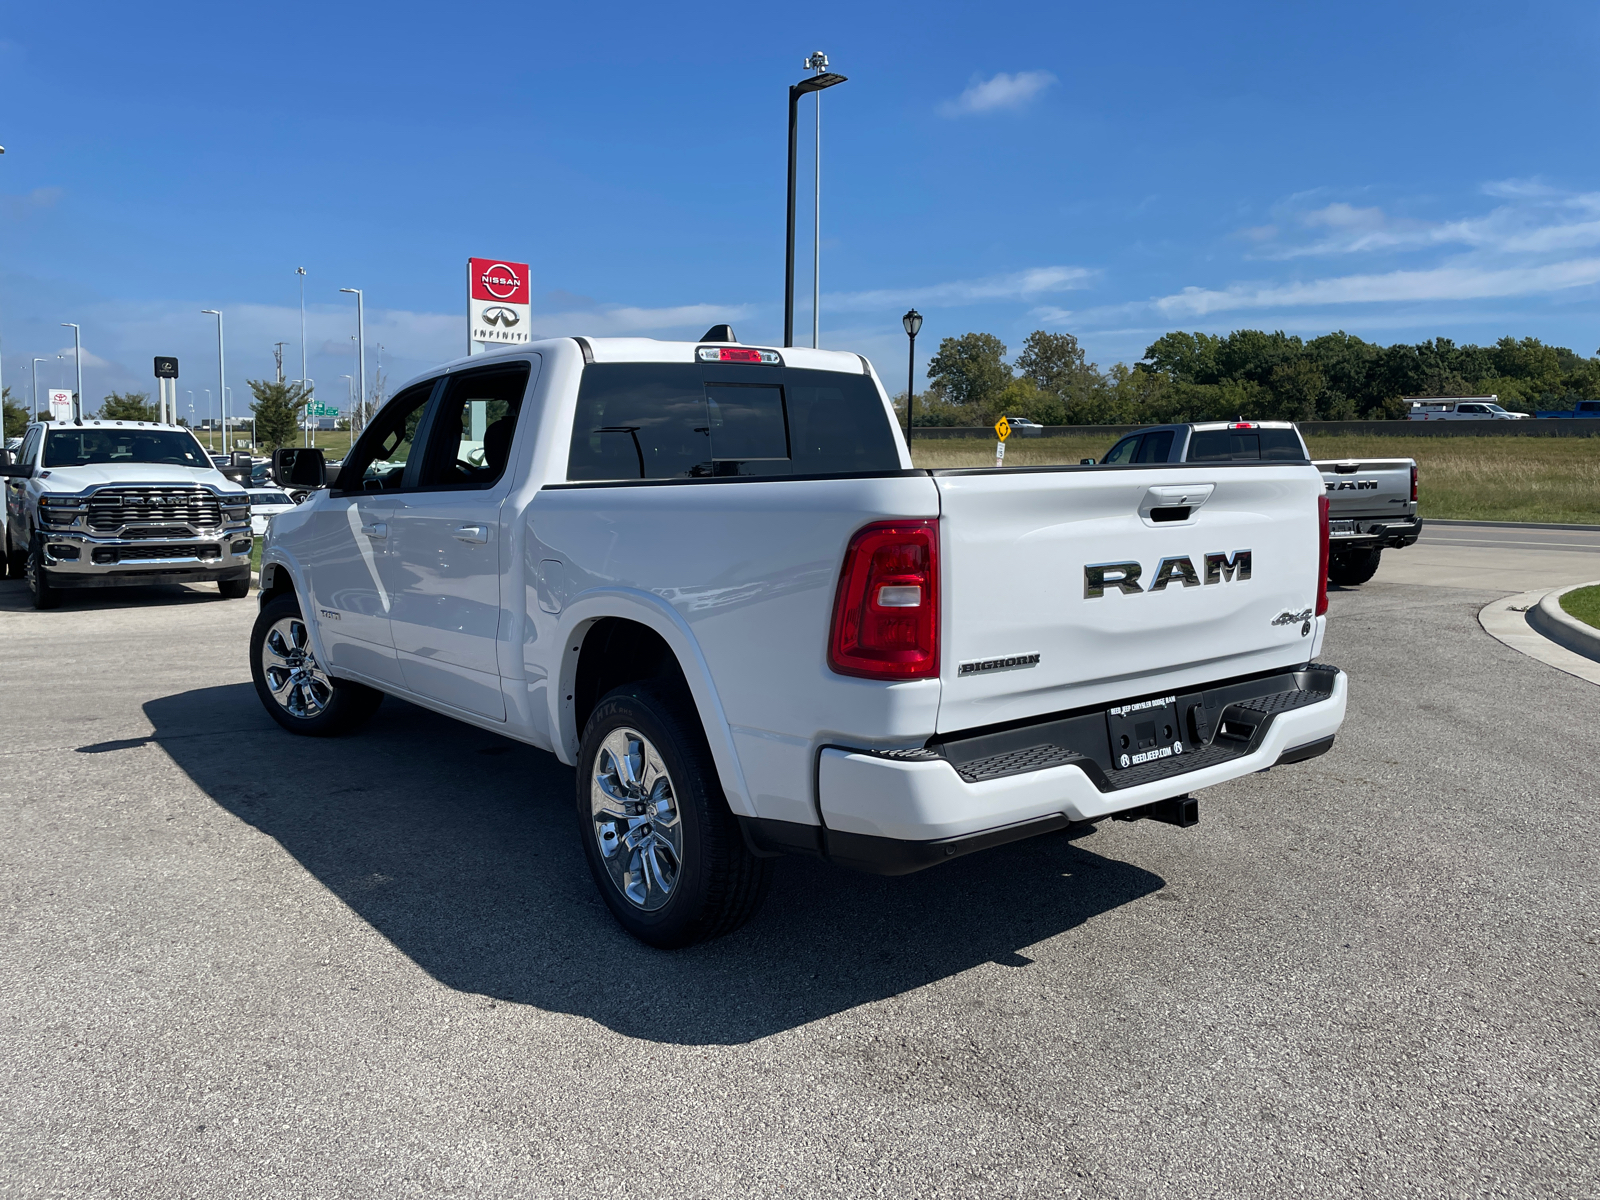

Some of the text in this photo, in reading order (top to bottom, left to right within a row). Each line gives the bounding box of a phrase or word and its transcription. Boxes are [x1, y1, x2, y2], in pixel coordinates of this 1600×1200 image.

[481, 275, 521, 287] NISSAN
[473, 329, 528, 342] INFINITI
[1324, 479, 1378, 491] RAM
[123, 496, 188, 505] RAM
[1083, 548, 1252, 600] RAM
[958, 653, 1041, 677] BIGHORN
[596, 702, 617, 722] HTX
[1111, 695, 1176, 715] REED JEEP CHRYSLER DODGE RAM
[1132, 747, 1172, 764] REEDJEEP.COM
